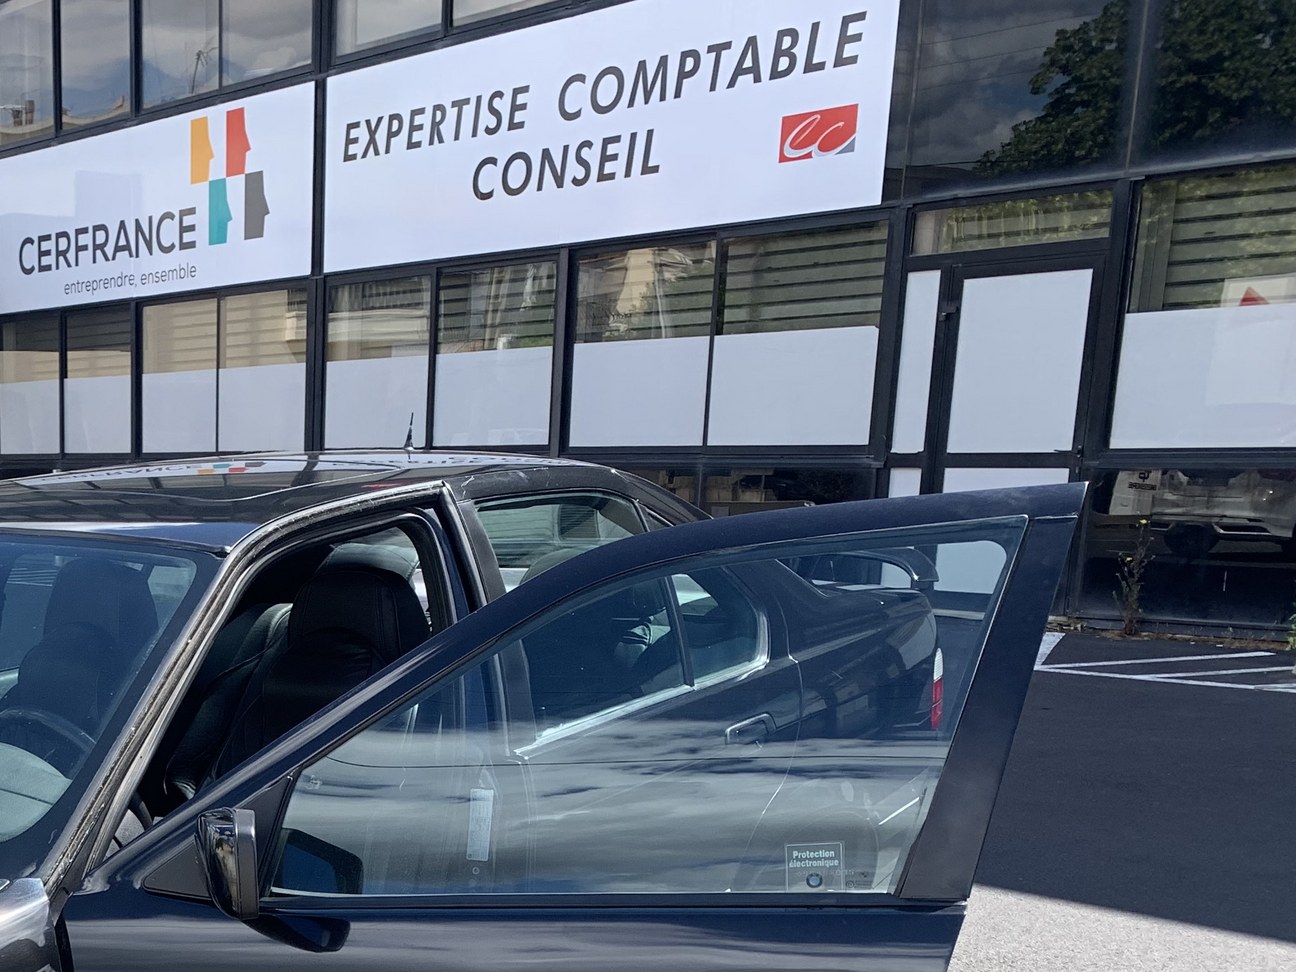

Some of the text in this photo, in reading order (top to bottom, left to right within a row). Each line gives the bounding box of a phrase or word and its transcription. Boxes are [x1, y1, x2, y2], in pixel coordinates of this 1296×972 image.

[342, 10, 868, 163] EXPERTISE COMPTABLE
[471, 128, 661, 202] CONSEIL
[18, 206, 197, 276] CERFRANCE
[63, 262, 197, 296] entreprendre, ensemble
[788, 858, 840, 868] électronique
[792, 849, 835, 859] Protection
